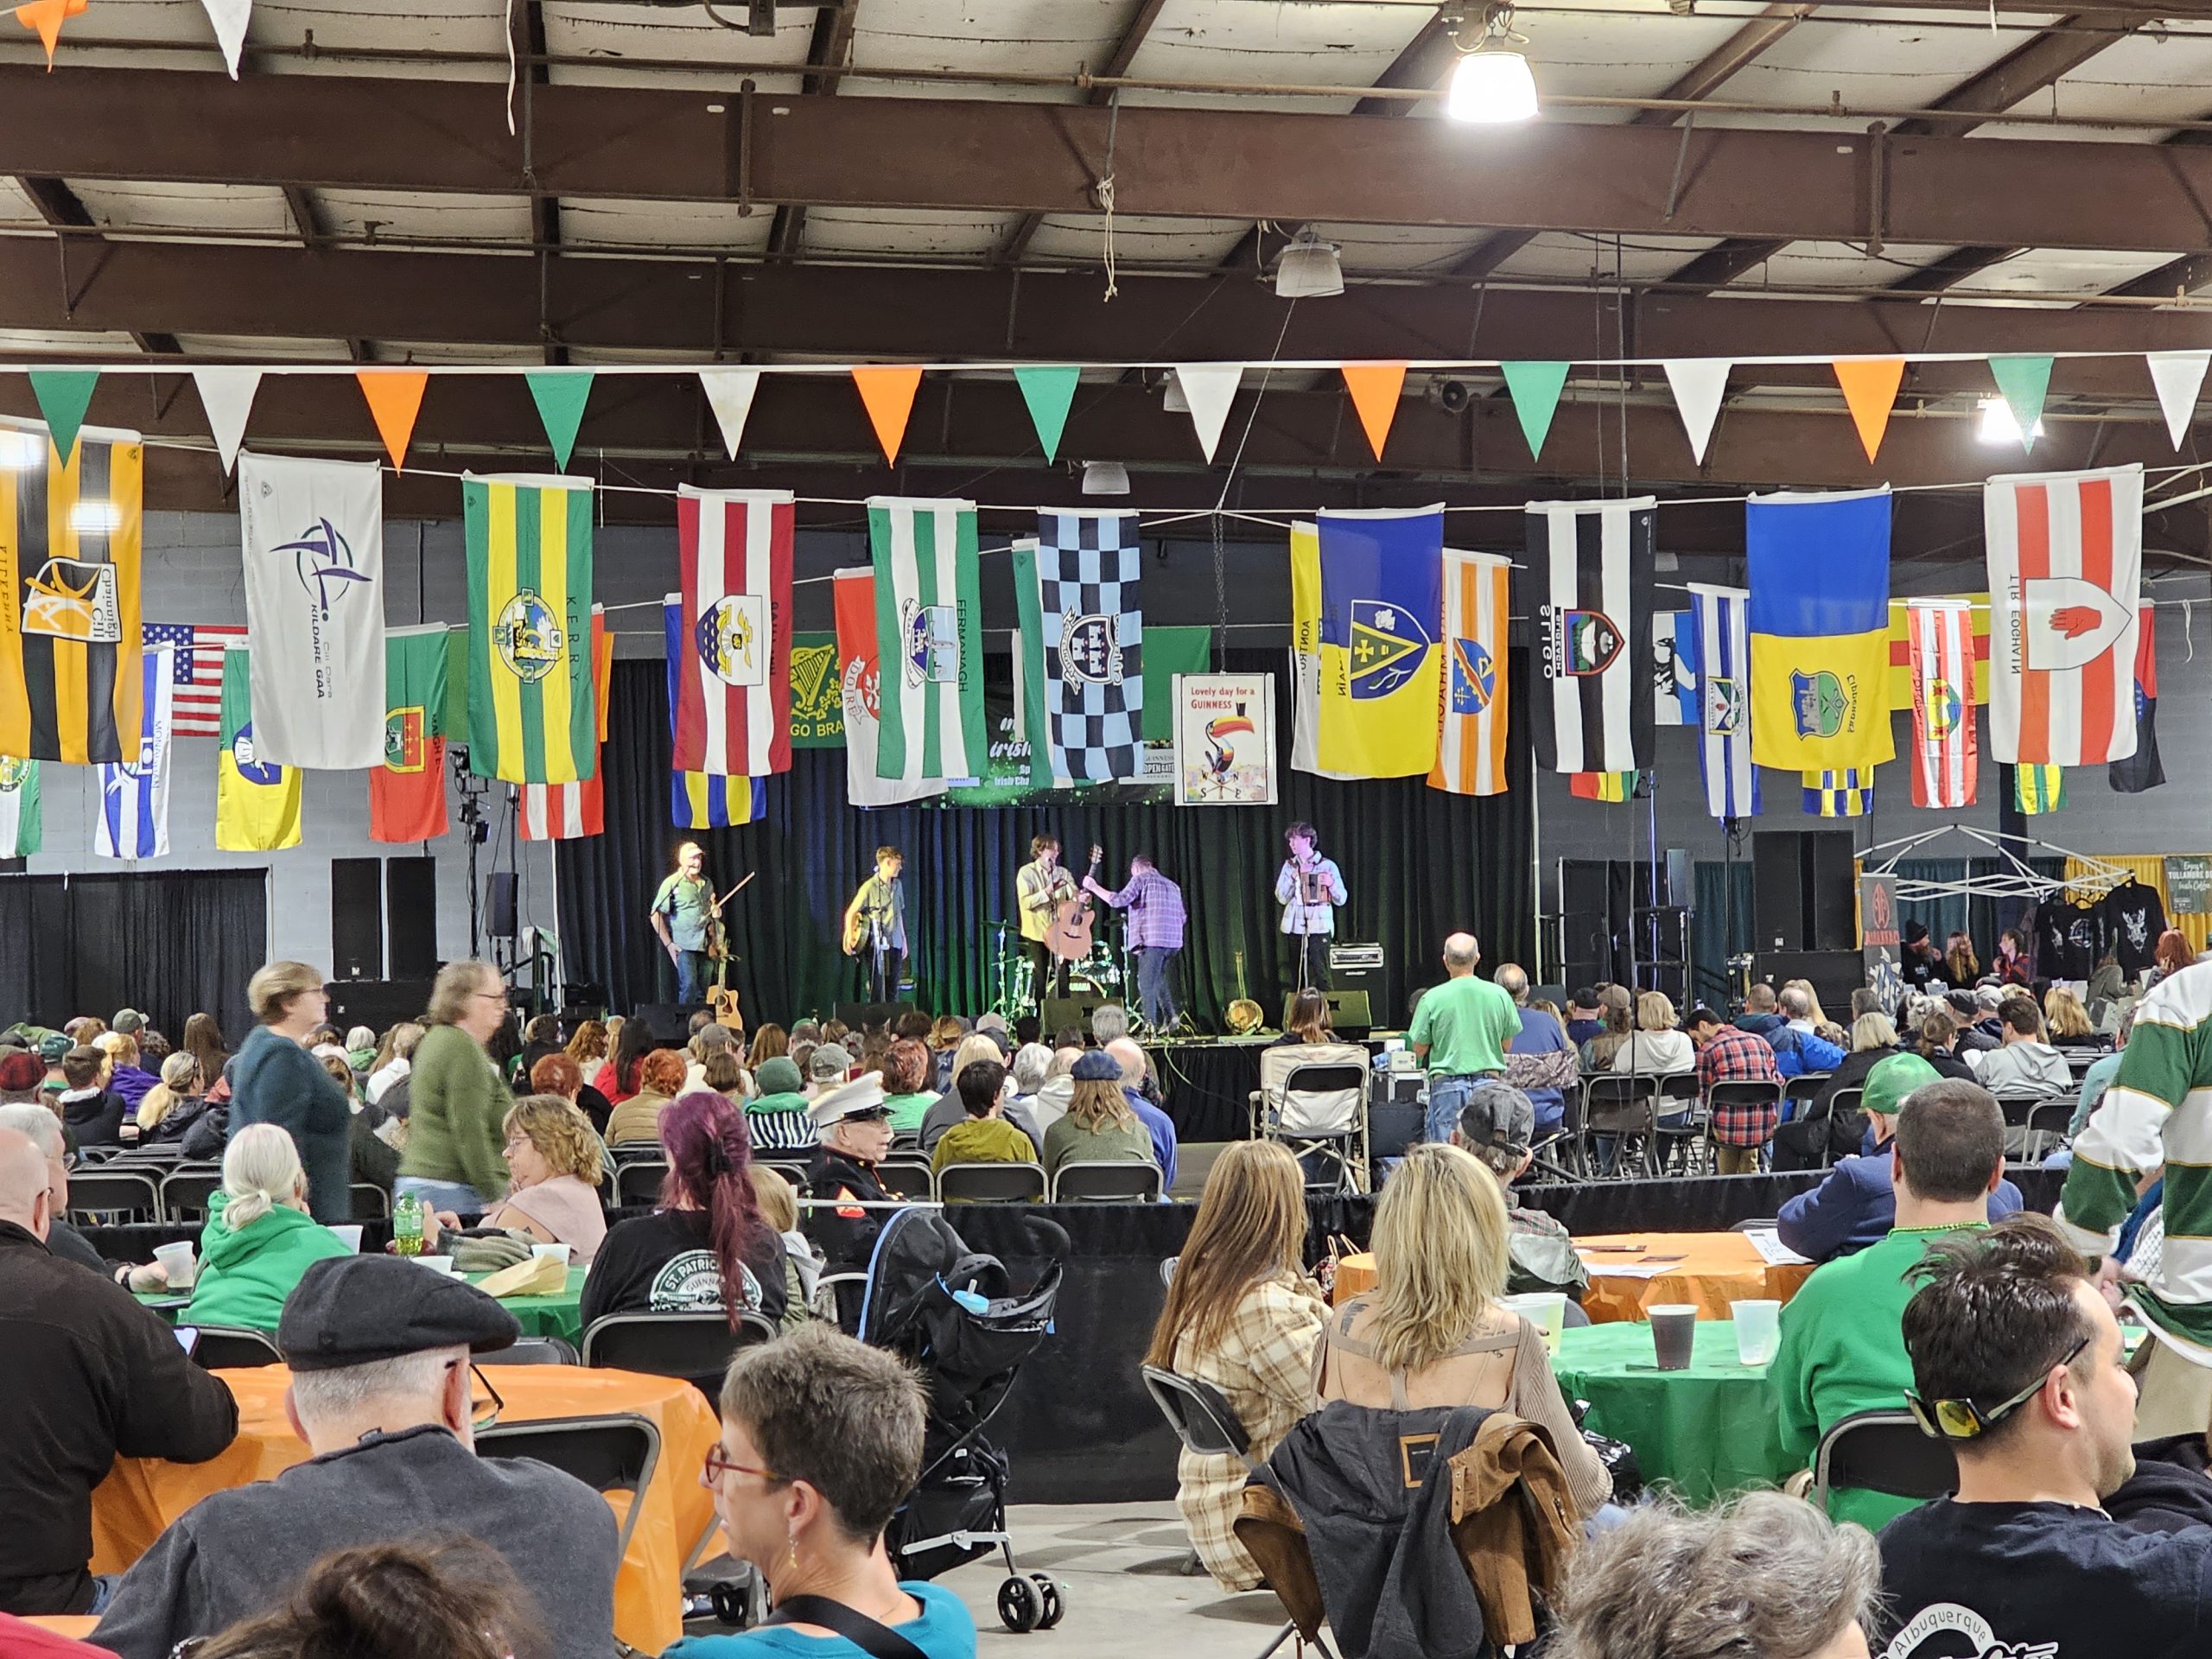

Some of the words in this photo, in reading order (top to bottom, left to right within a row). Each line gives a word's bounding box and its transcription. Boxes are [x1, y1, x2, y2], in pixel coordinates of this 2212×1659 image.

[311, 604, 321, 664] KILDARE
[566, 596, 580, 682] KERRY
[957, 600, 969, 692] FERMANAGH
[315, 669, 325, 699] GAA
[845, 663, 861, 716] DOIRE
[1191, 687, 1217, 697] Lovely
[1219, 687, 1234, 697] day
[1236, 686, 1248, 696] for
[1191, 699, 1232, 709] GUINNESS
[790, 723, 810, 737] GO
[1144, 763, 1160, 774] OPEN
[2168, 870, 2204, 880] TULLAMORE
[664, 1271, 683, 1291] ST.
[677, 1258, 720, 1278] PATRIC
[1893, 1610, 1987, 1656] Albuquerque
